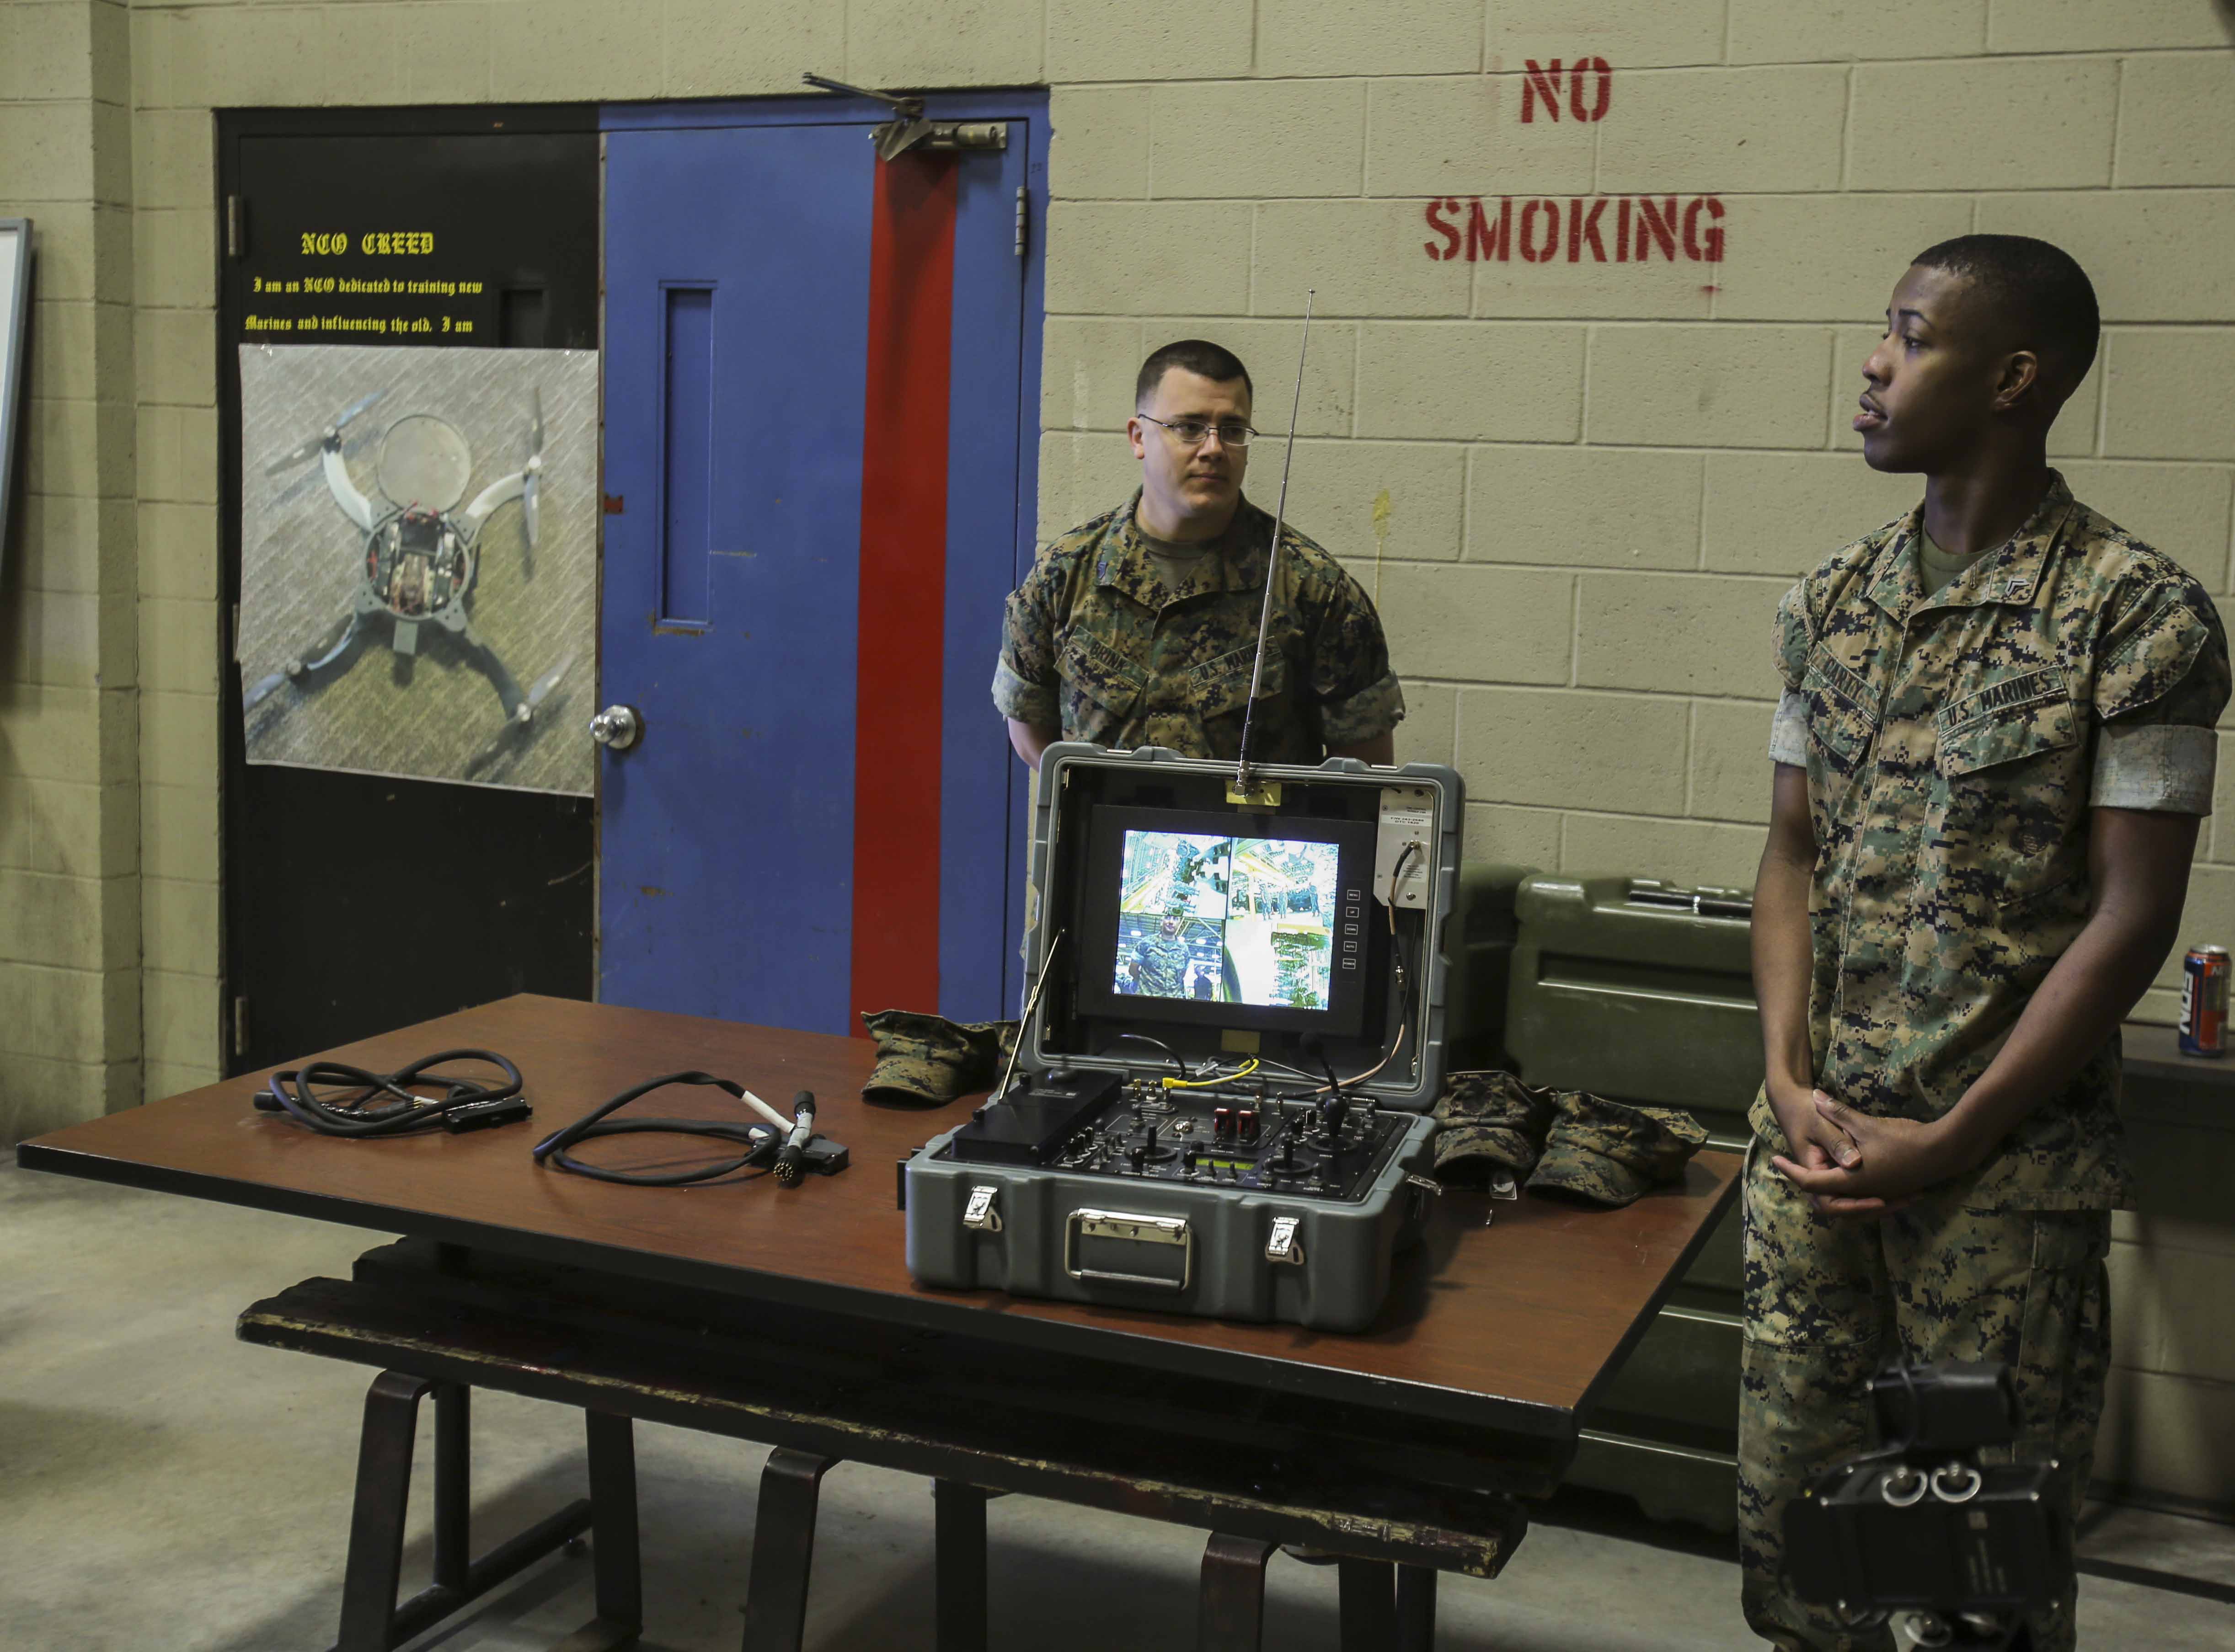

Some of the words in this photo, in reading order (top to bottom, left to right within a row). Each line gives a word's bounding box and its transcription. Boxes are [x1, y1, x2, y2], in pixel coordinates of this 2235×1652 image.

[1521, 57, 1612, 123] NO
[301, 232, 348, 255] NCO
[362, 232, 433, 255] CREED
[1424, 196, 1726, 263] SMOKING
[253, 276, 262, 293] I
[265, 281, 282, 293] am
[286, 281, 299, 293] an
[304, 277, 335, 293] NCO
[338, 277, 390, 293] dedicated
[393, 279, 405, 293] to
[407, 279, 455, 296] training
[459, 282, 482, 293] new
[245, 314, 292, 331] Marines
[298, 314, 318, 330] and
[321, 315, 386, 334] influencing
[391, 316, 409, 335] the
[412, 317, 432, 332] old.
[455, 321, 473, 332] am
[1947, 701, 1973, 726] U.S.
[1980, 671, 2051, 711] MARINES
